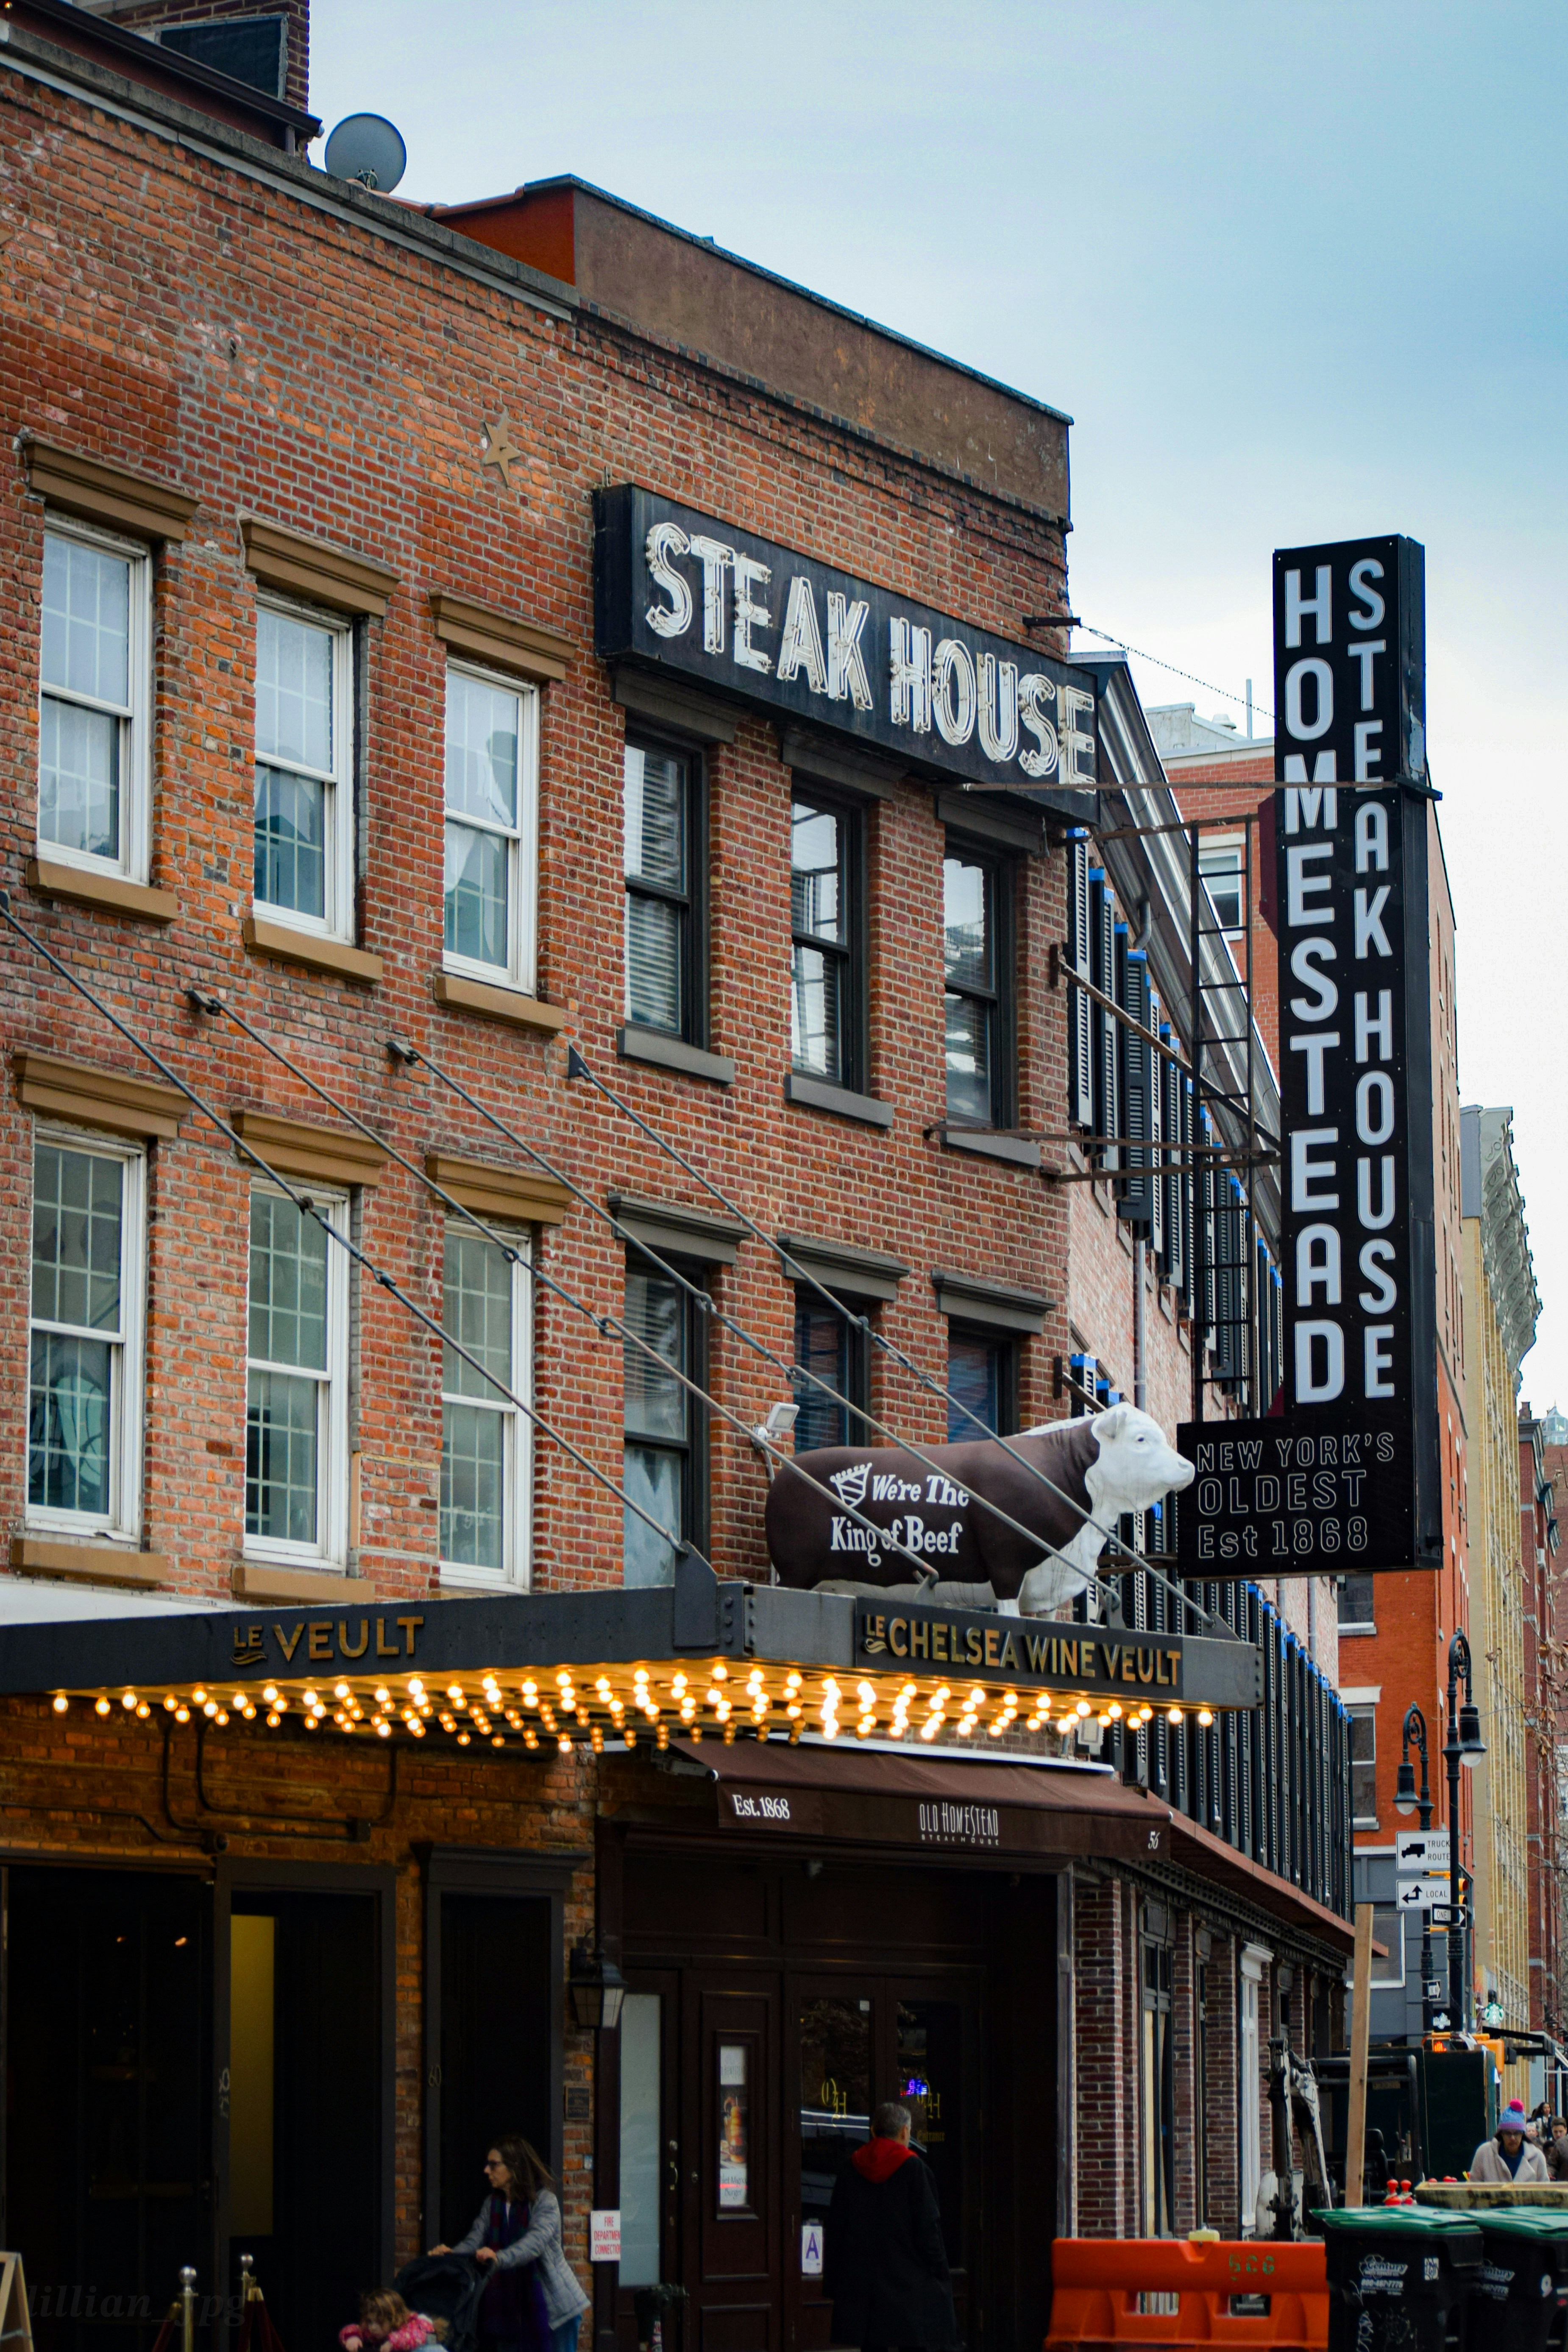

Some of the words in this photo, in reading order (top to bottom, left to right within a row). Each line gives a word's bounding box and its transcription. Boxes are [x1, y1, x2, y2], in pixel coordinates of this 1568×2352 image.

[645, 522, 873, 711] STEAK
[890, 616, 1096, 795] HOUSE
[1284, 565, 1345, 1403] HOMESTEAD
[1198, 1440, 1262, 1472] NEW
[1276, 1432, 1394, 1467] YORK'S
[872, 1474, 921, 1502] We're
[926, 1475, 969, 1507] The
[1198, 1470, 1366, 1515] OLDEST
[831, 1516, 881, 1567] King
[904, 1515, 963, 1554] Beef
[1198, 1525, 1258, 1559] Est
[1273, 1516, 1367, 1555] 1868
[234, 1625, 263, 1648] LE
[272, 1616, 424, 1662] VEULT
[866, 1614, 885, 1637] LE
[888, 1617, 1019, 1669] CHELSEA
[1025, 1634, 1096, 1678] WINE
[1103, 1643, 1181, 1686] VEULT
[760, 1796, 790, 1820] 1868
[919, 1804, 938, 1832] OLD
[941, 1802, 999, 1837] HOMESTEAD
[1148, 1830, 1161, 1849] 56
[1427, 1840, 1451, 1848] TRUCK
[1427, 1853, 1451, 1861] ROUTE
[1426, 1890, 1448, 1898] LOCAL
[1437, 1910, 1447, 1920] ONE
[594, 2230, 621, 2241] DEPARTMEN
[604, 2216, 614, 2227] FIRE
[805, 2232, 819, 2259] A
